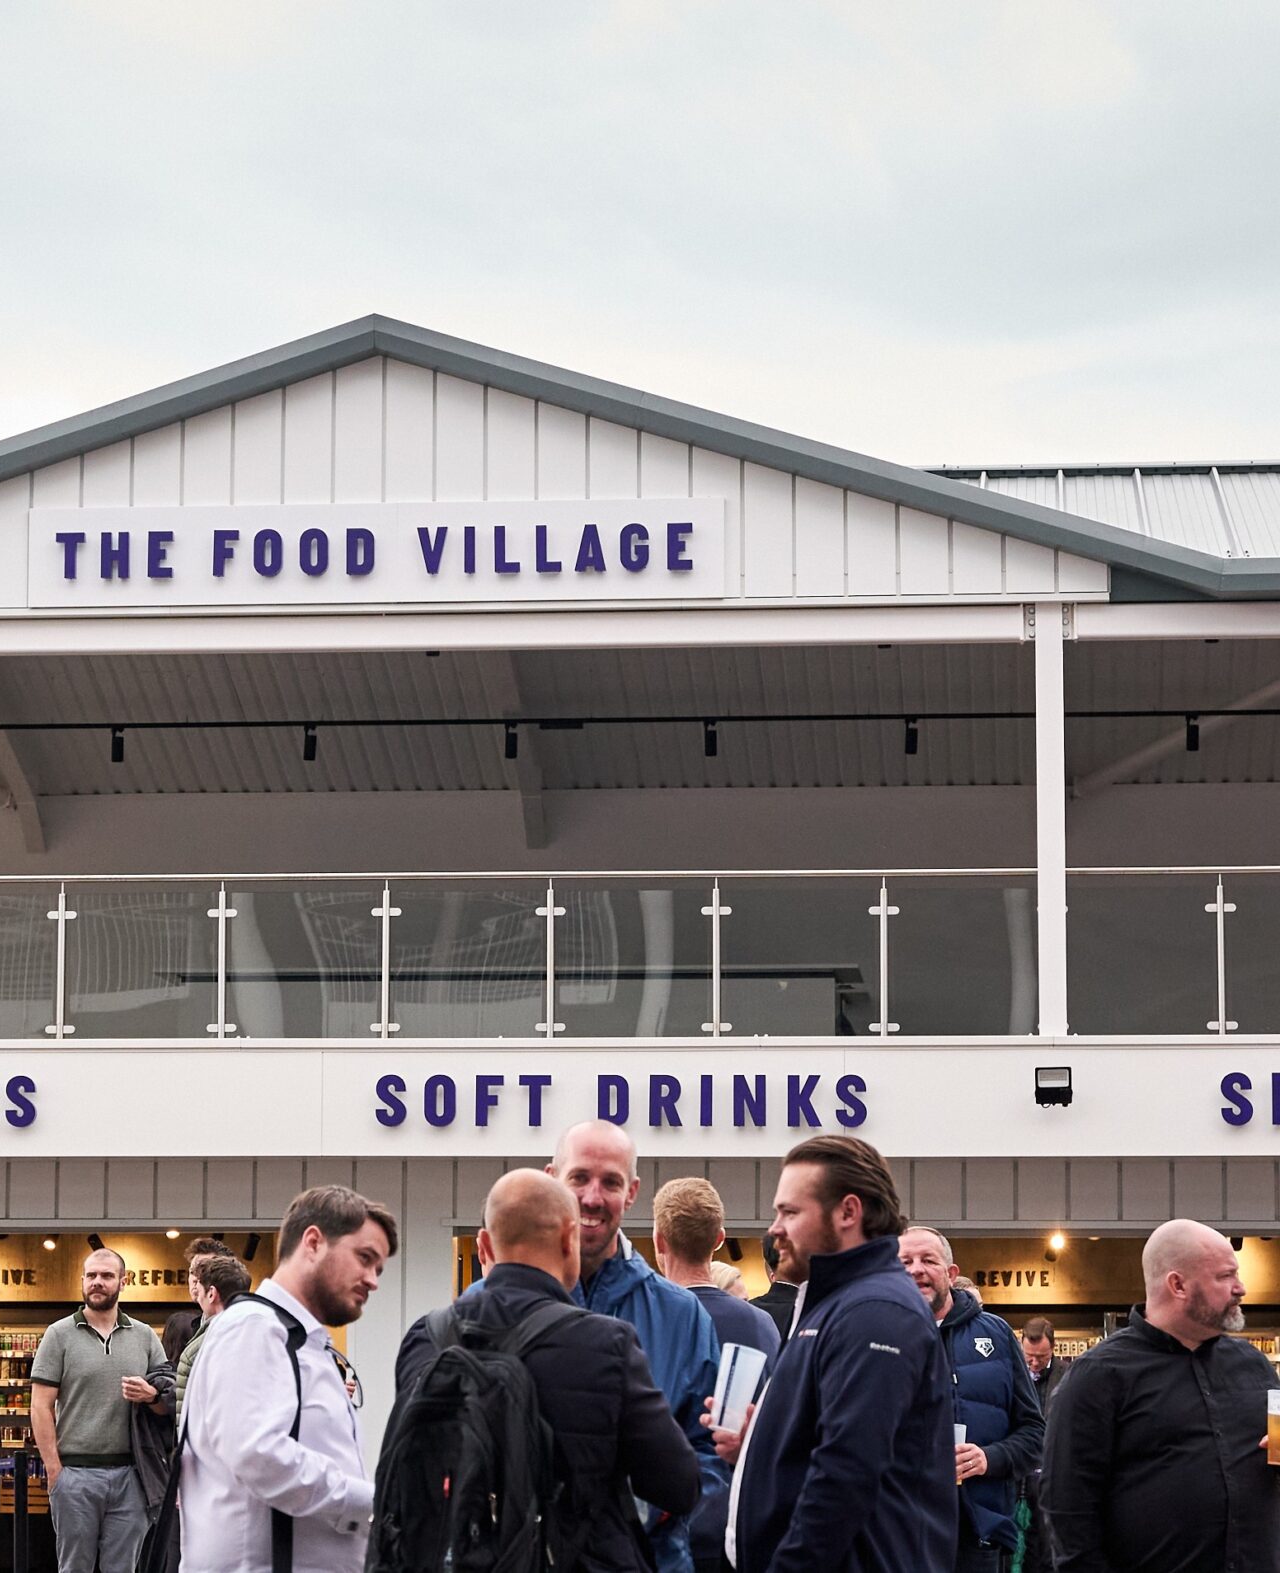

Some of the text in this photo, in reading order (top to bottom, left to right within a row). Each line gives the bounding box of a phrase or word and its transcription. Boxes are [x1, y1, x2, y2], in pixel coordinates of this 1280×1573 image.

[55, 522, 694, 580] THE FOOD VILLAGE
[375, 1074, 868, 1129] SOFT DRINKS
[124, 1268, 190, 1286] REFRE
[976, 1270, 1050, 1287] REVIVE
